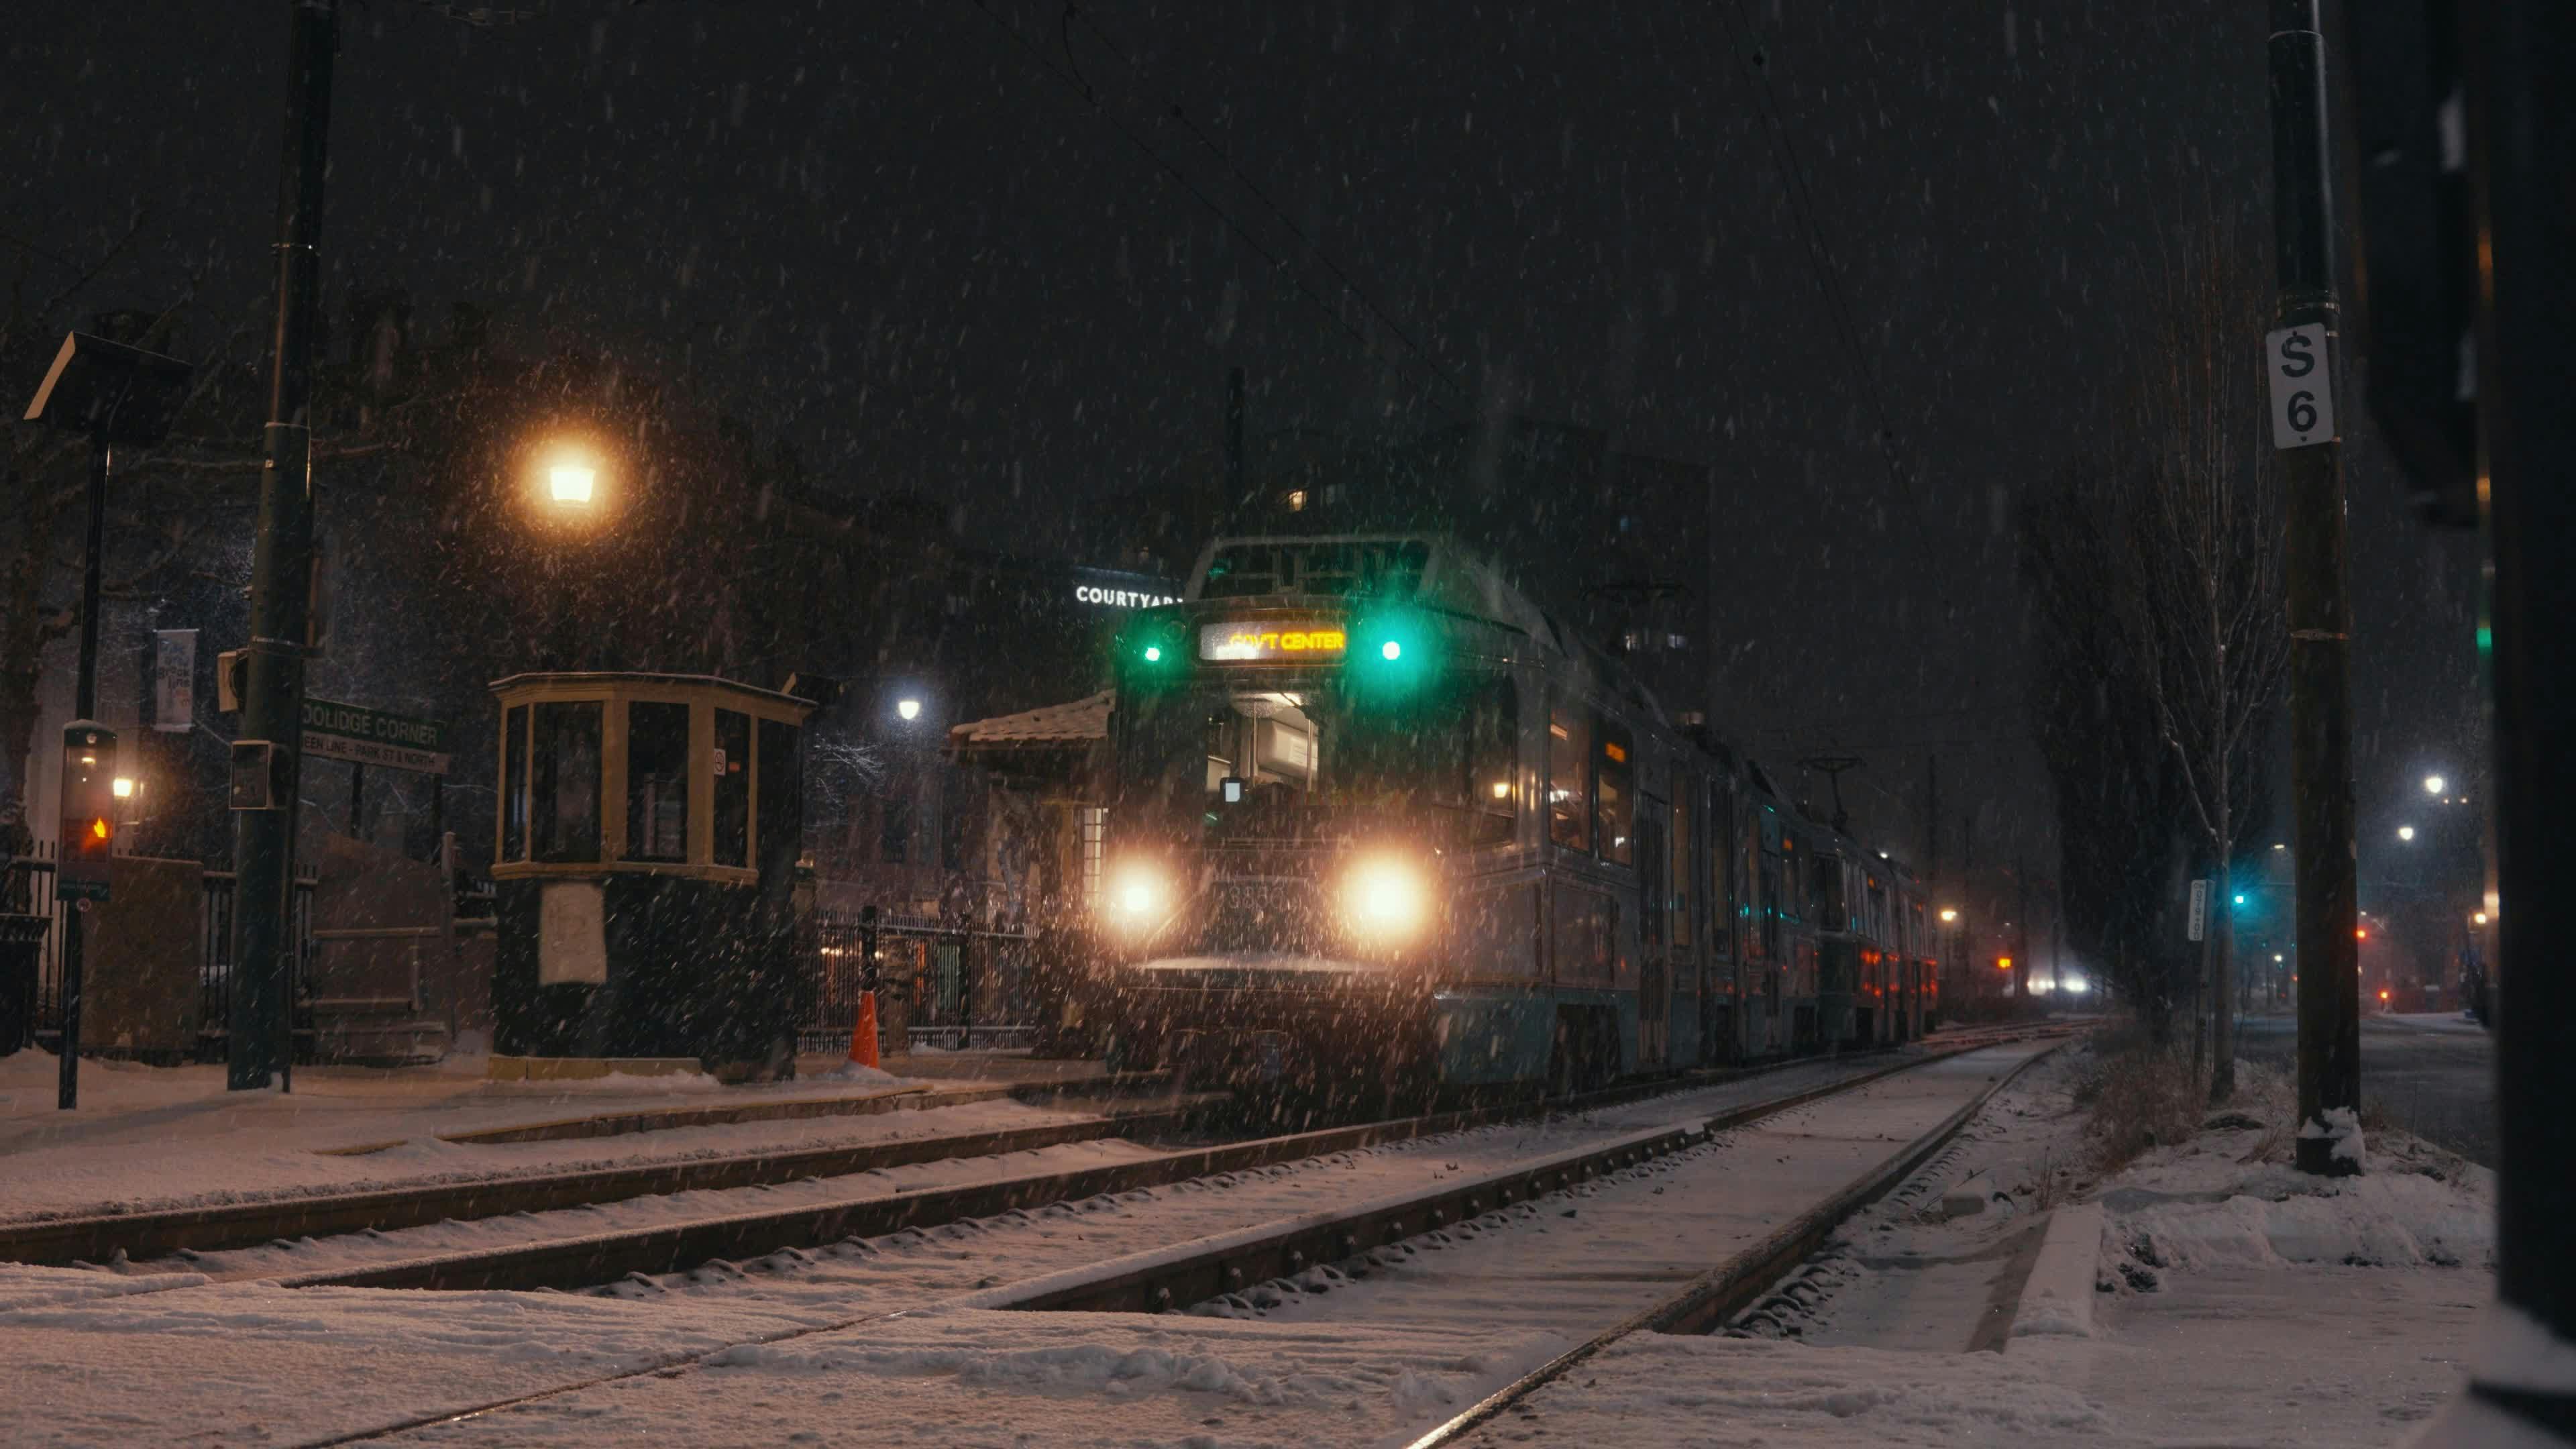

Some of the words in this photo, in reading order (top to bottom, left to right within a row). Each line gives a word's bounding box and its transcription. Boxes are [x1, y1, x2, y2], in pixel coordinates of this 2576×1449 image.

[2282, 335, 2315, 378] S
[2288, 390, 2317, 432] 6
[1281, 632, 1344, 651] CENTER
[375, 717, 436, 746] CORNER
